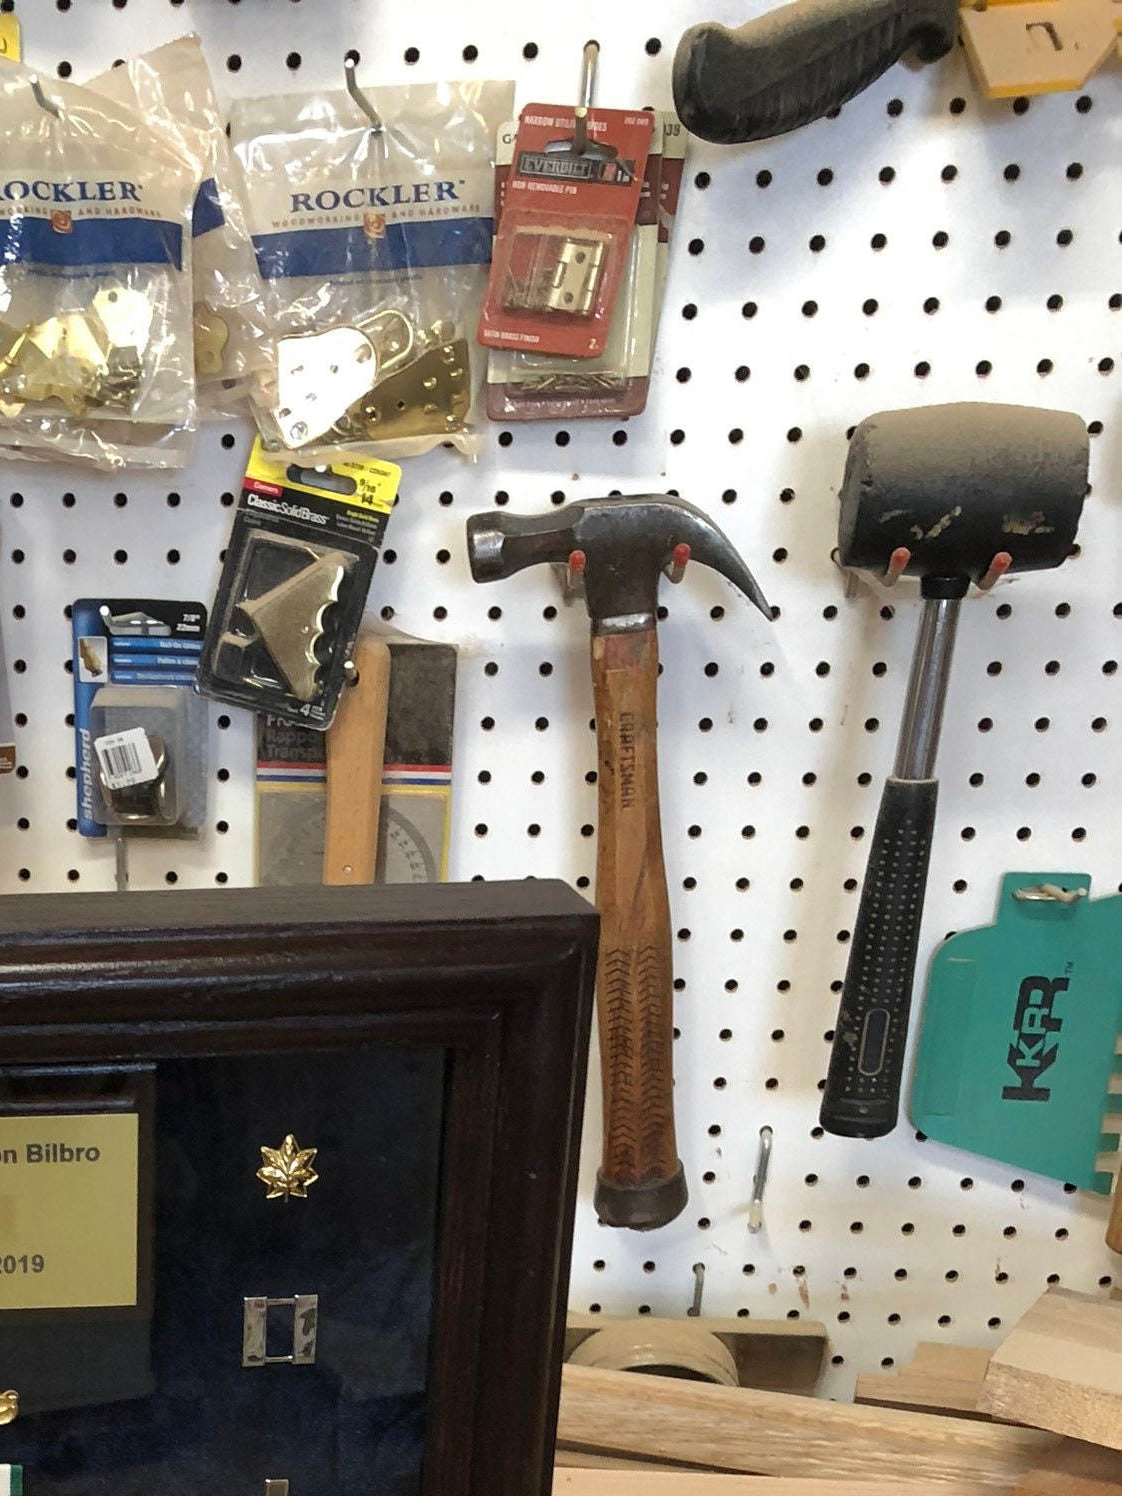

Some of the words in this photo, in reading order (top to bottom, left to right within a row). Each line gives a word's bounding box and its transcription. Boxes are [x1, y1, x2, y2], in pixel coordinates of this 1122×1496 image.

[523, 157, 589, 176] EVERBILT
[290, 180, 460, 213] ROCKLER
[78, 206, 101, 216] AND
[271, 212, 360, 228] WOODWORKING
[391, 210, 414, 219] AND
[419, 204, 481, 217] HARDWARE
[619, 712, 636, 809] CRAFTSMAN
[79, 728, 93, 820] shepherd
[26, 1143, 101, 1164] Bilbro
